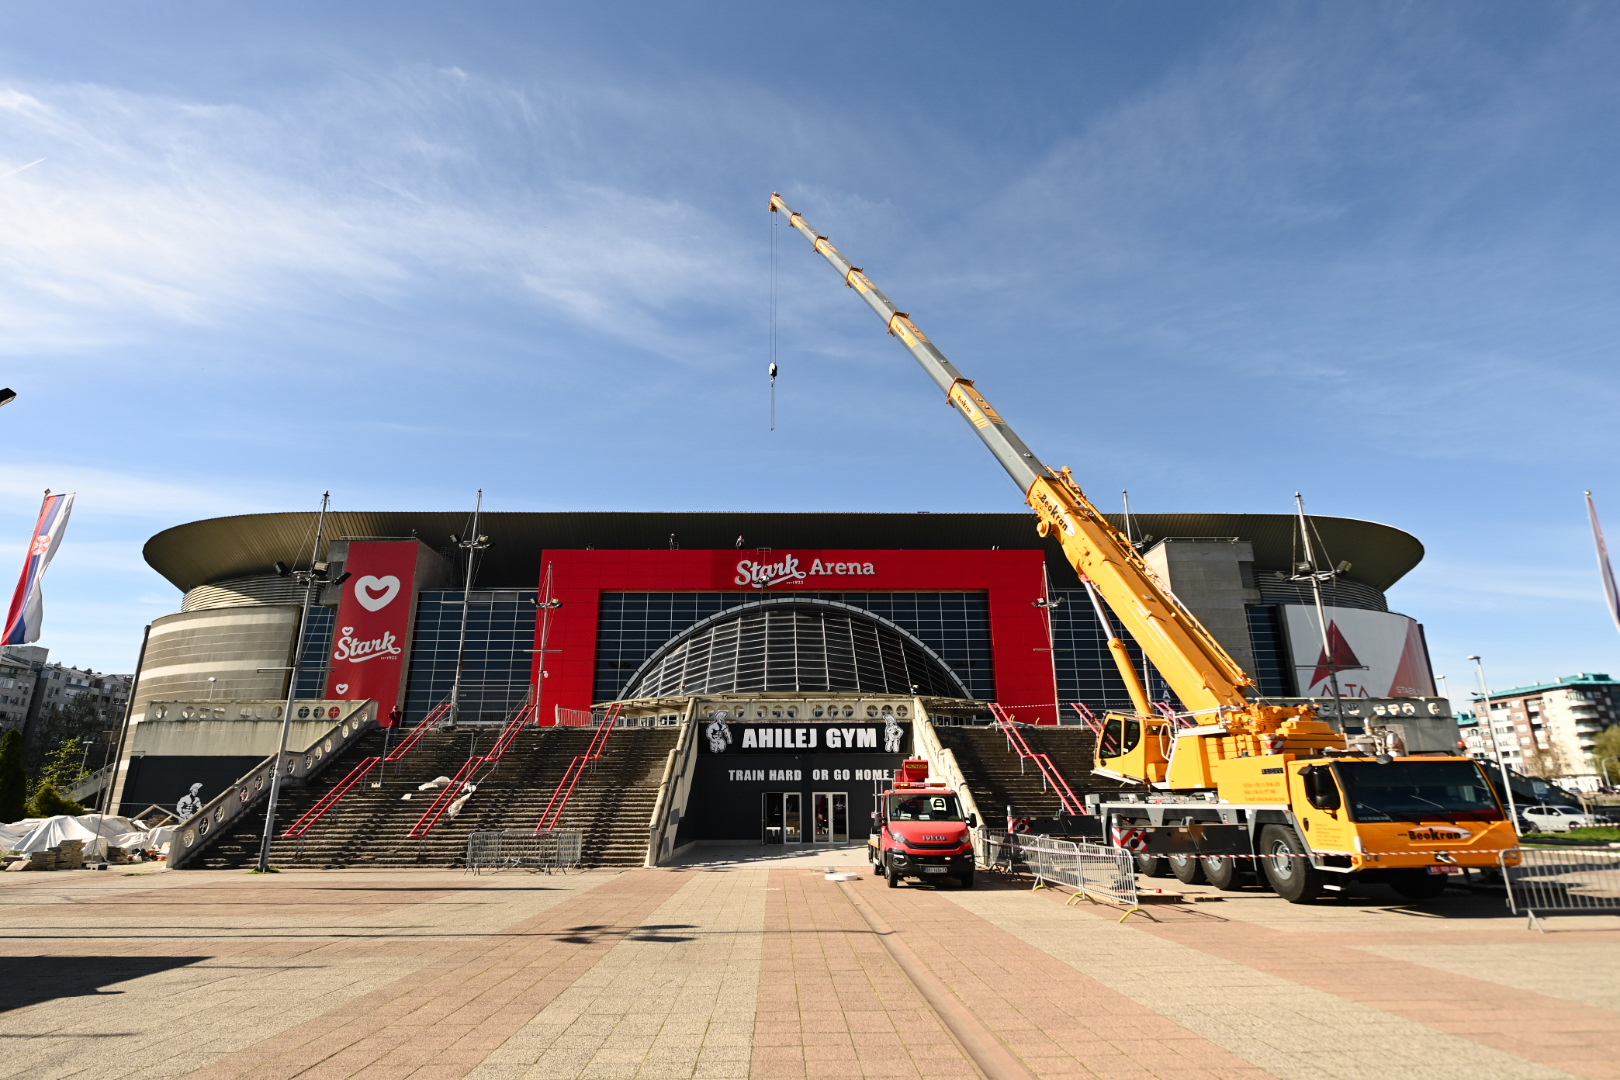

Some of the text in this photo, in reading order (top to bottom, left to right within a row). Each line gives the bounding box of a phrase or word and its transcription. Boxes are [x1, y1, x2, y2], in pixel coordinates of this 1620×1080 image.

[1040, 494, 1068, 531] Beokran
[809, 559, 875, 575] Arena
[741, 728, 877, 749] AHILEJ GYM
[728, 769, 889, 781] TRAIN HARD OR GO HOME
[1408, 828, 1461, 840] Beokran
